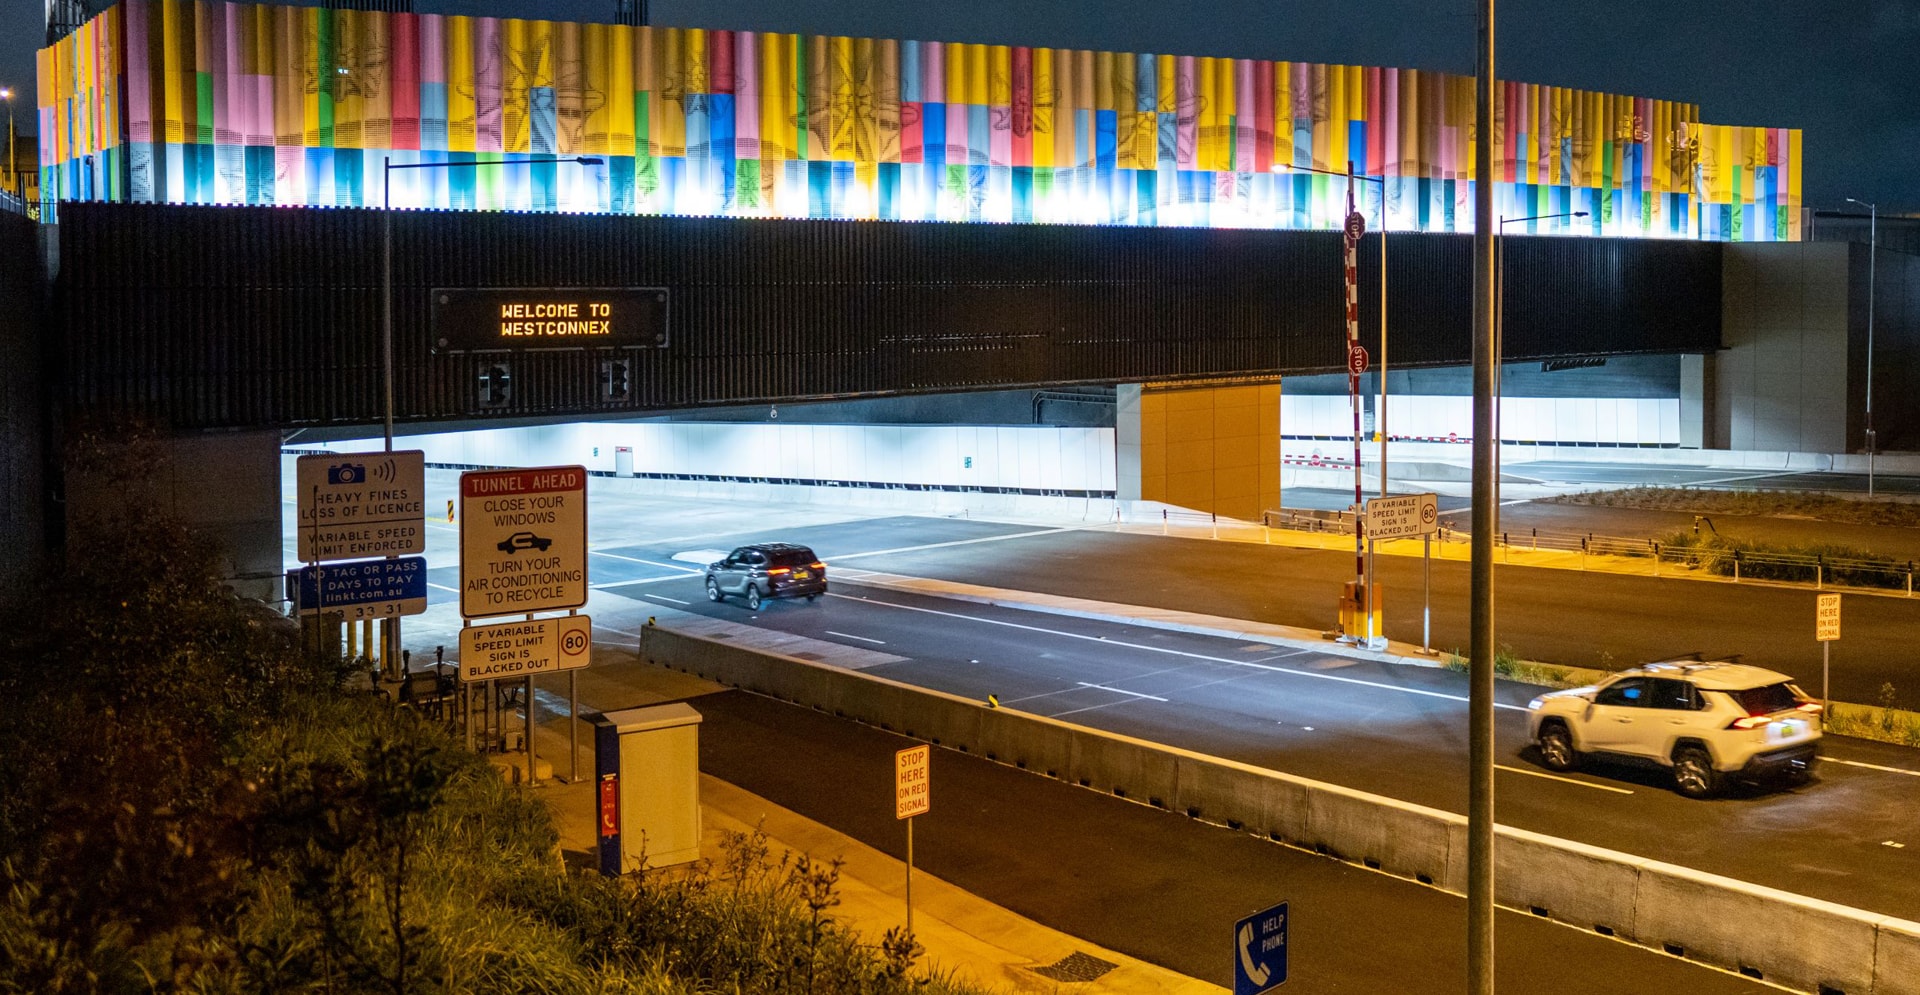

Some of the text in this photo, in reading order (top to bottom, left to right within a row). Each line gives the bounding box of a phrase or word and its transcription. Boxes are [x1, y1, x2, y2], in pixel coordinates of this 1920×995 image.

[1351, 213, 1359, 238] STOP
[501, 303, 610, 319] WELCOME TO
[501, 321, 610, 336] WESTCONNEX
[472, 474, 576, 493] TUNNEL AHEAD
[370, 490, 408, 501] FINES
[1382, 499, 1416, 508] VARIABLE
[302, 502, 420, 519] LOSS OF LICENCE
[484, 496, 564, 512] CLOSE YOUR
[494, 512, 556, 527] WINDOWS
[1372, 508, 1416, 519] SPEED LIMIT
[1423, 509, 1434, 519] 80
[308, 528, 415, 544] VARIABLE SPEED
[1370, 525, 1418, 537] BLACKED OUT
[350, 540, 413, 553] ENFORCED
[308, 562, 418, 580] NO TAG OR PASS
[488, 557, 561, 574] TURN YOUR
[329, 580, 361, 590] DAYS
[368, 578, 381, 587] TO
[388, 575, 413, 584] PAY
[467, 570, 581, 591] AIR CONDITIONING
[326, 588, 402, 602] linkt.com.au
[486, 586, 564, 604] TO RECYCLE
[1821, 597, 1838, 607] STOP
[356, 607, 375, 618] 33
[385, 604, 401, 614] 31
[1820, 608, 1838, 617] HERE
[473, 625, 545, 640] IF VARIABLE
[475, 636, 544, 652] SPEED LIMIT
[565, 636, 584, 649] 80
[490, 650, 530, 662] SIGN IS
[469, 659, 549, 676] BLACKED OUT
[901, 751, 925, 768] STOP
[900, 767, 925, 784] HERE
[900, 782, 927, 799] ON RED
[900, 797, 927, 813] SIGNAL
[1262, 914, 1284, 934] HELP
[1262, 932, 1284, 953] PHONE
